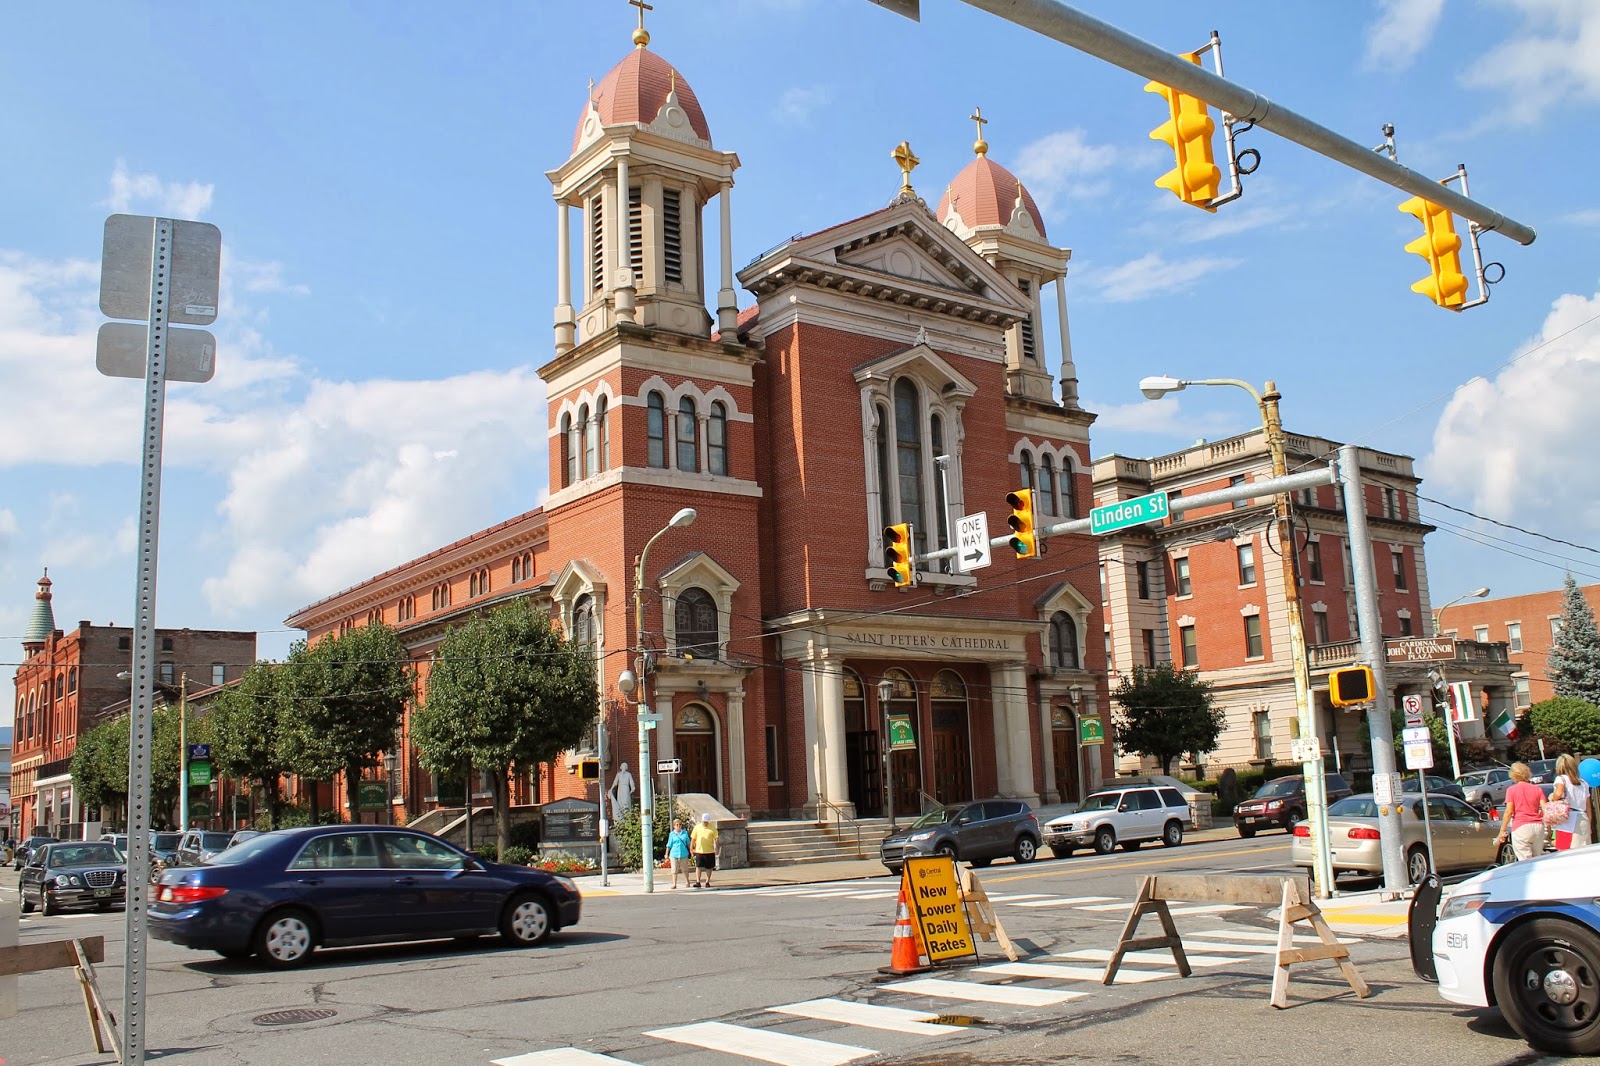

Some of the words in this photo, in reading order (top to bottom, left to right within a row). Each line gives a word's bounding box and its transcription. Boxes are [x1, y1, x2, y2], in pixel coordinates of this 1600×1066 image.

[1094, 503, 1143, 527] Linden
[1149, 496, 1165, 513] St
[961, 519, 981, 535] ONE
[962, 532, 983, 548] WAY
[847, 632, 885, 645] SAINT
[891, 634, 936, 647] PETER'S
[941, 637, 1010, 650] CATHEDRAL
[1400, 640, 1439, 648] CARDINAL
[1387, 647, 1406, 656] JOHN
[1415, 644, 1453, 654] O'CONNOR
[919, 886, 947, 899] New
[918, 903, 956, 918] Lower
[926, 919, 958, 935] Daily
[930, 938, 967, 953] Rates
[1447, 932, 1469, 949] SD1
